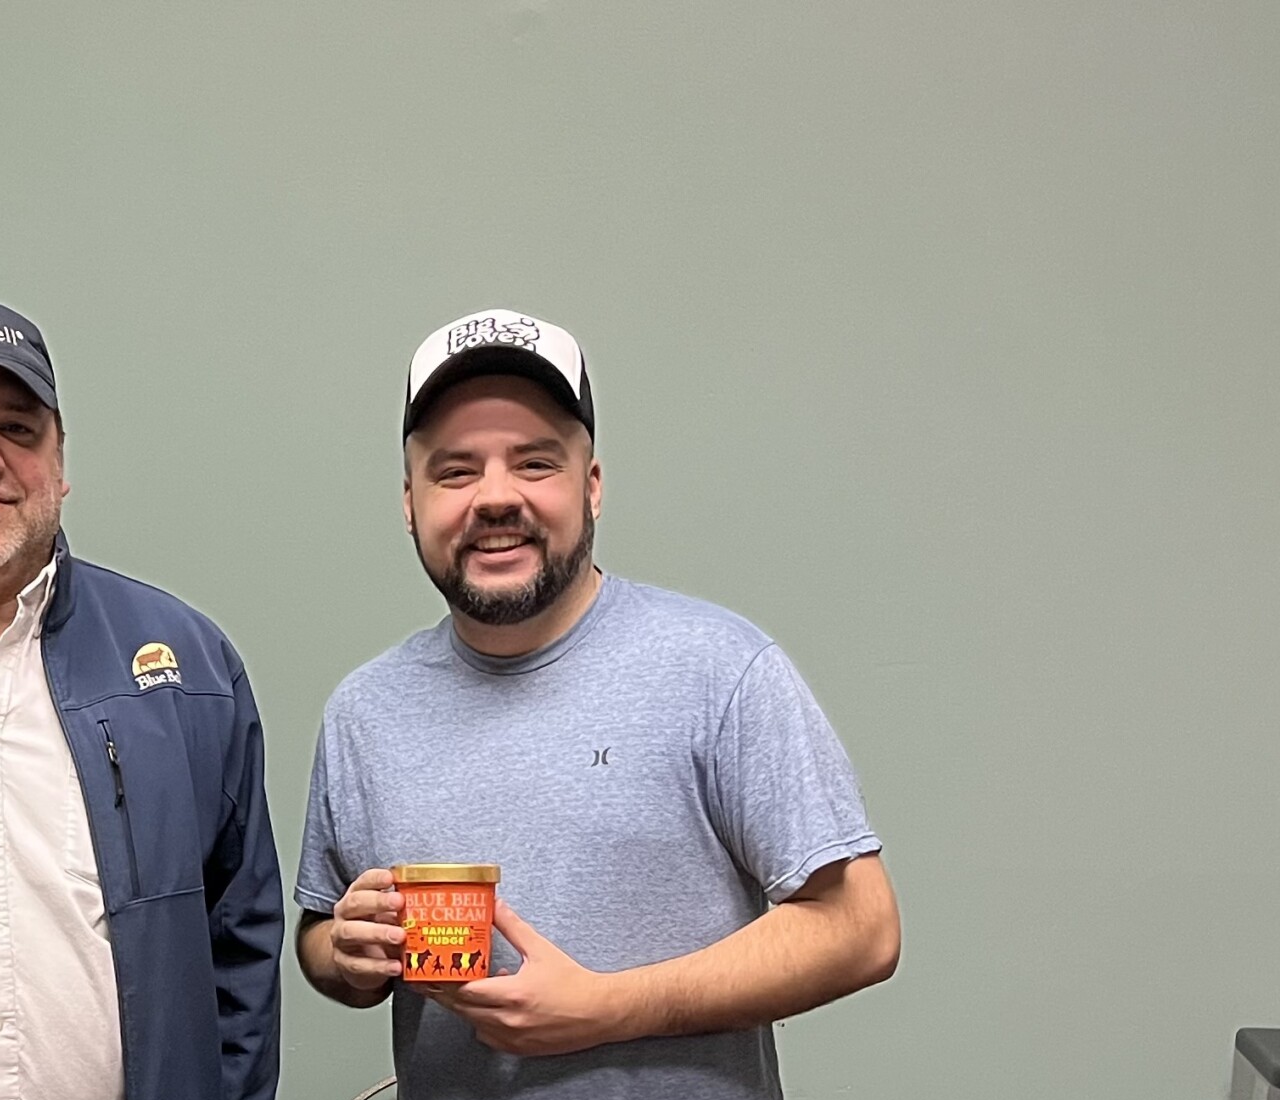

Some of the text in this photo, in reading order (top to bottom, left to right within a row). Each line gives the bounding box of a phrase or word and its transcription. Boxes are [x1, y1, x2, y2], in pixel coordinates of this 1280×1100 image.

[134, 673, 168, 691] Blue
[405, 892, 487, 907] BLUE BELL
[431, 907, 487, 922] CREAM
[421, 926, 471, 936] BANANA
[428, 936, 465, 946] FUDGE
